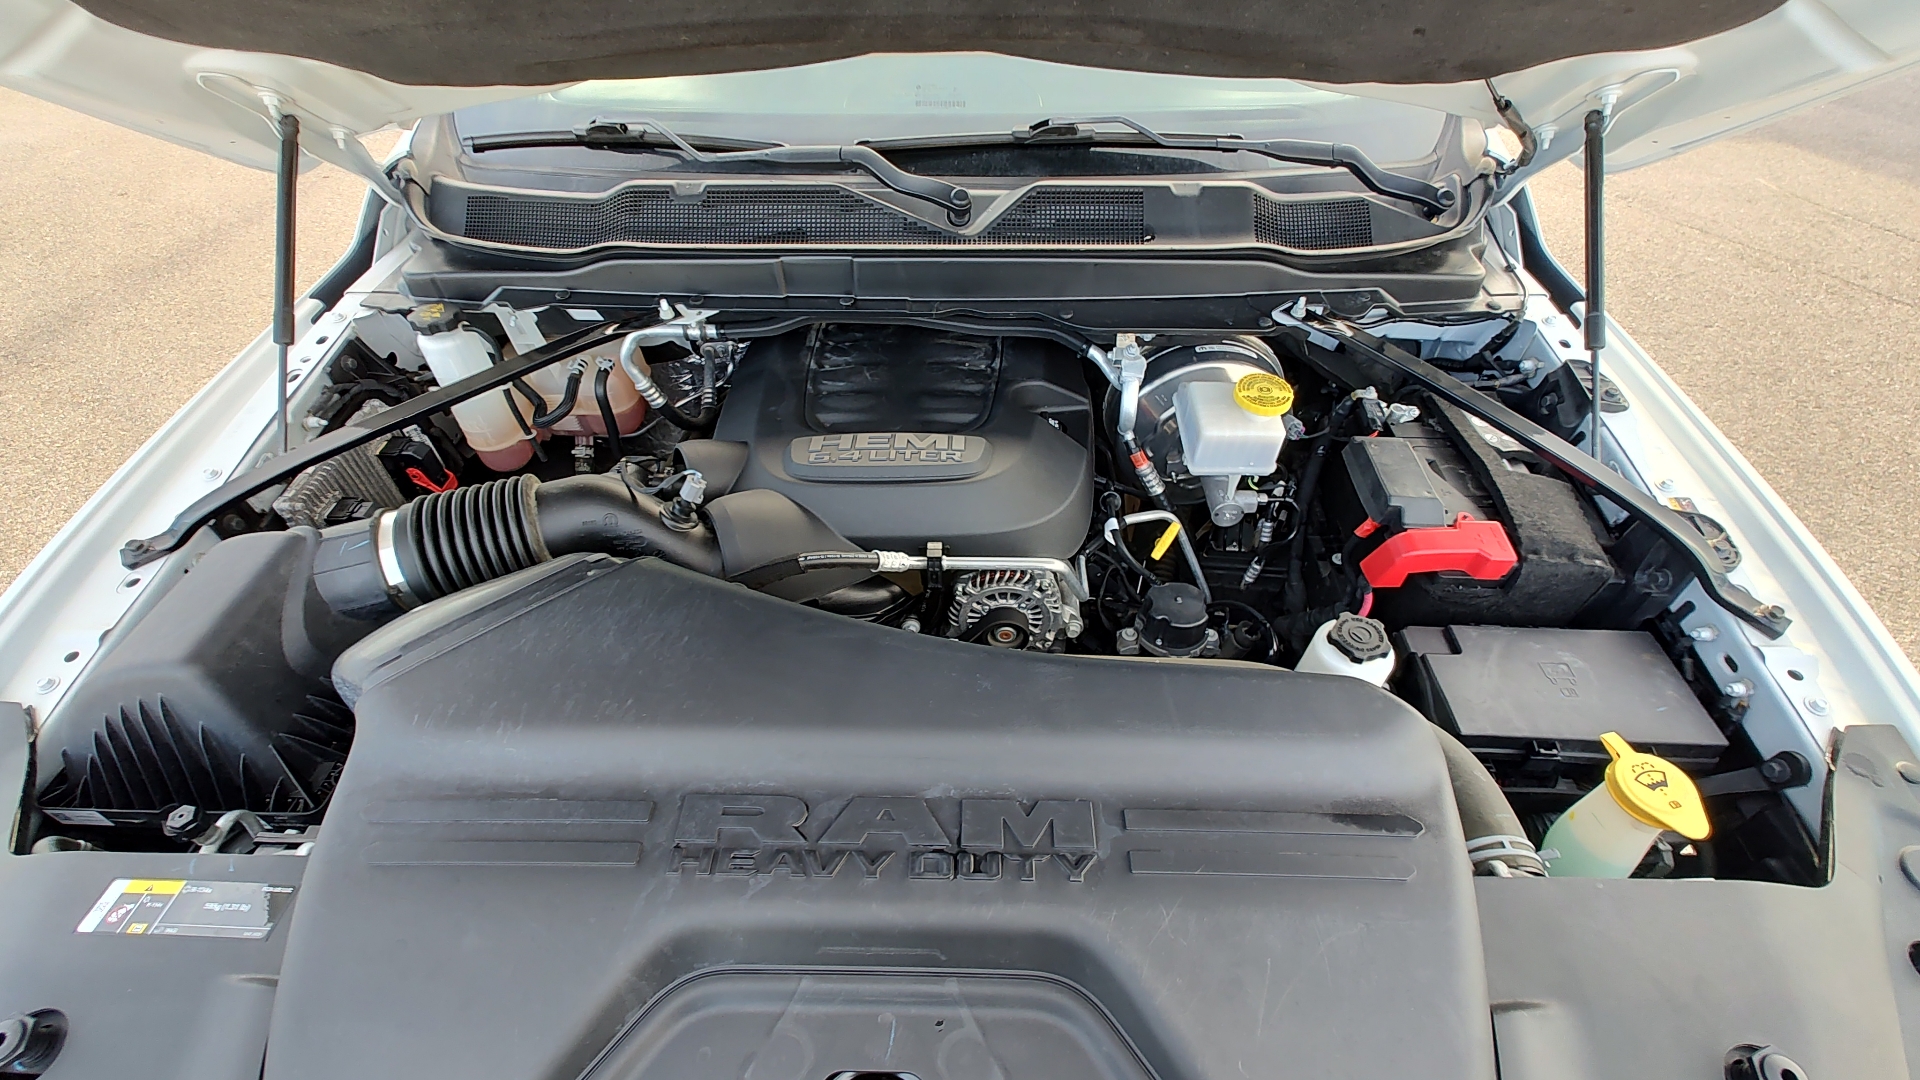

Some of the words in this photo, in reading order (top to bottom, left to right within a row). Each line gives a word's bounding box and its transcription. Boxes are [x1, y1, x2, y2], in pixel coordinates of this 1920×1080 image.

[809, 434, 965, 451] HEMI
[808, 450, 863, 464] 6.4
[868, 449, 963, 462] LITER
[674, 794, 1097, 850] RAM
[665, 847, 897, 879] HEAVY
[908, 850, 1098, 883] DUTY
